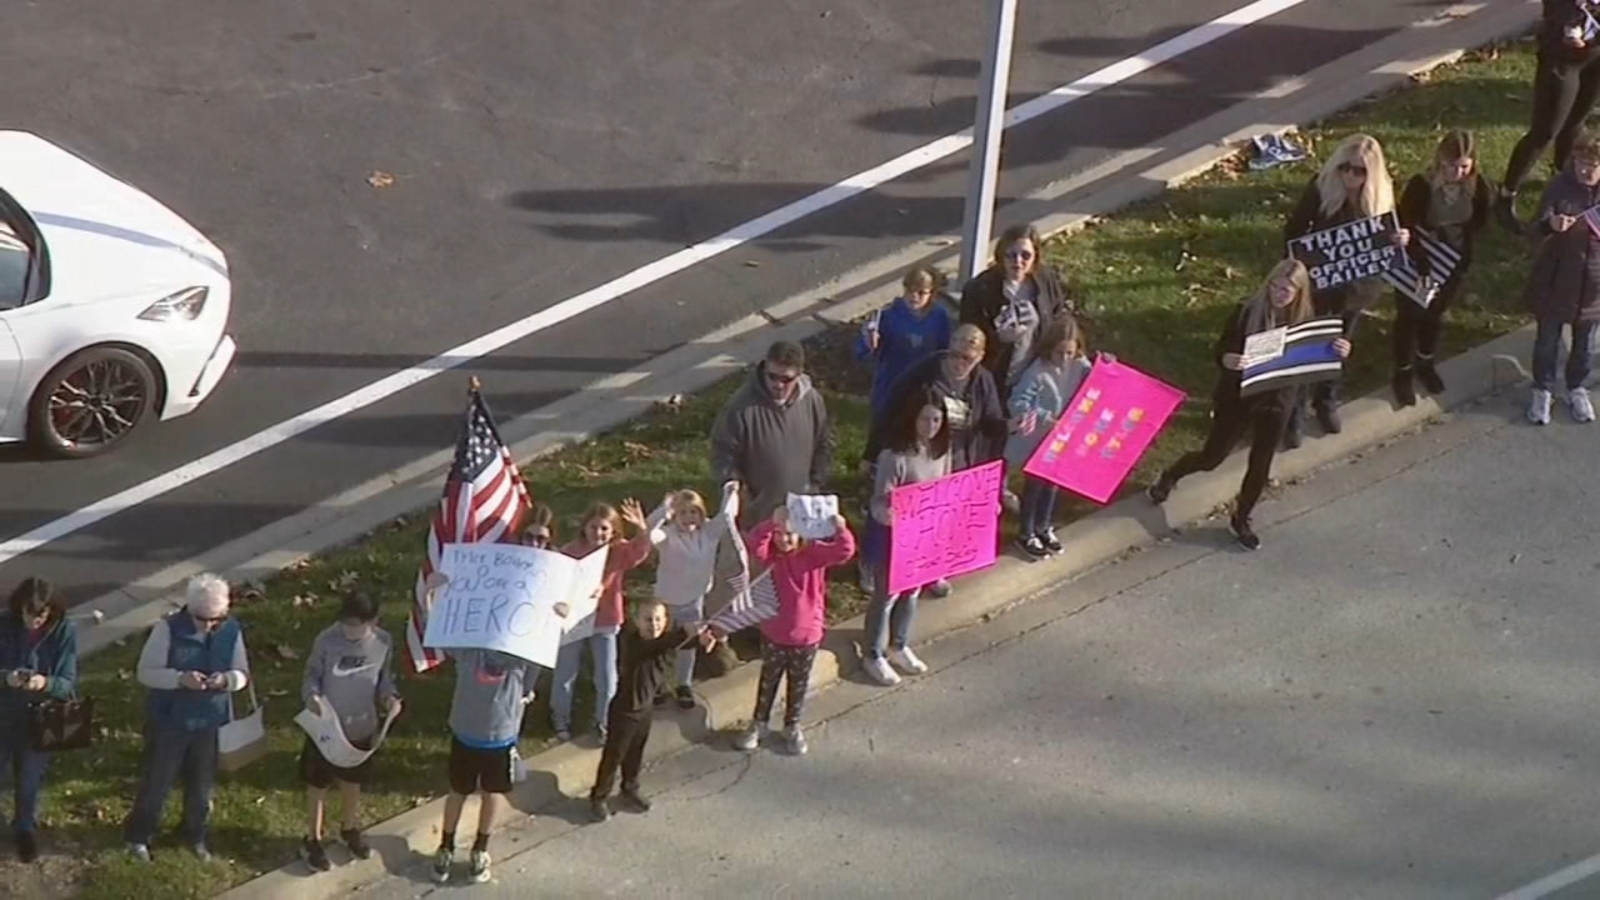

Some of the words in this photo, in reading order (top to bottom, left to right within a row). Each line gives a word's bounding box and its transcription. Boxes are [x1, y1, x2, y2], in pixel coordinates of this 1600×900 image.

[1301, 216, 1386, 252] THANK
[1323, 237, 1373, 262] YOU
[1308, 245, 1396, 280] OFFICER
[1315, 258, 1393, 290] BAILEY
[1042, 388, 1101, 463] WELCOME
[443, 598, 536, 637] HERO
